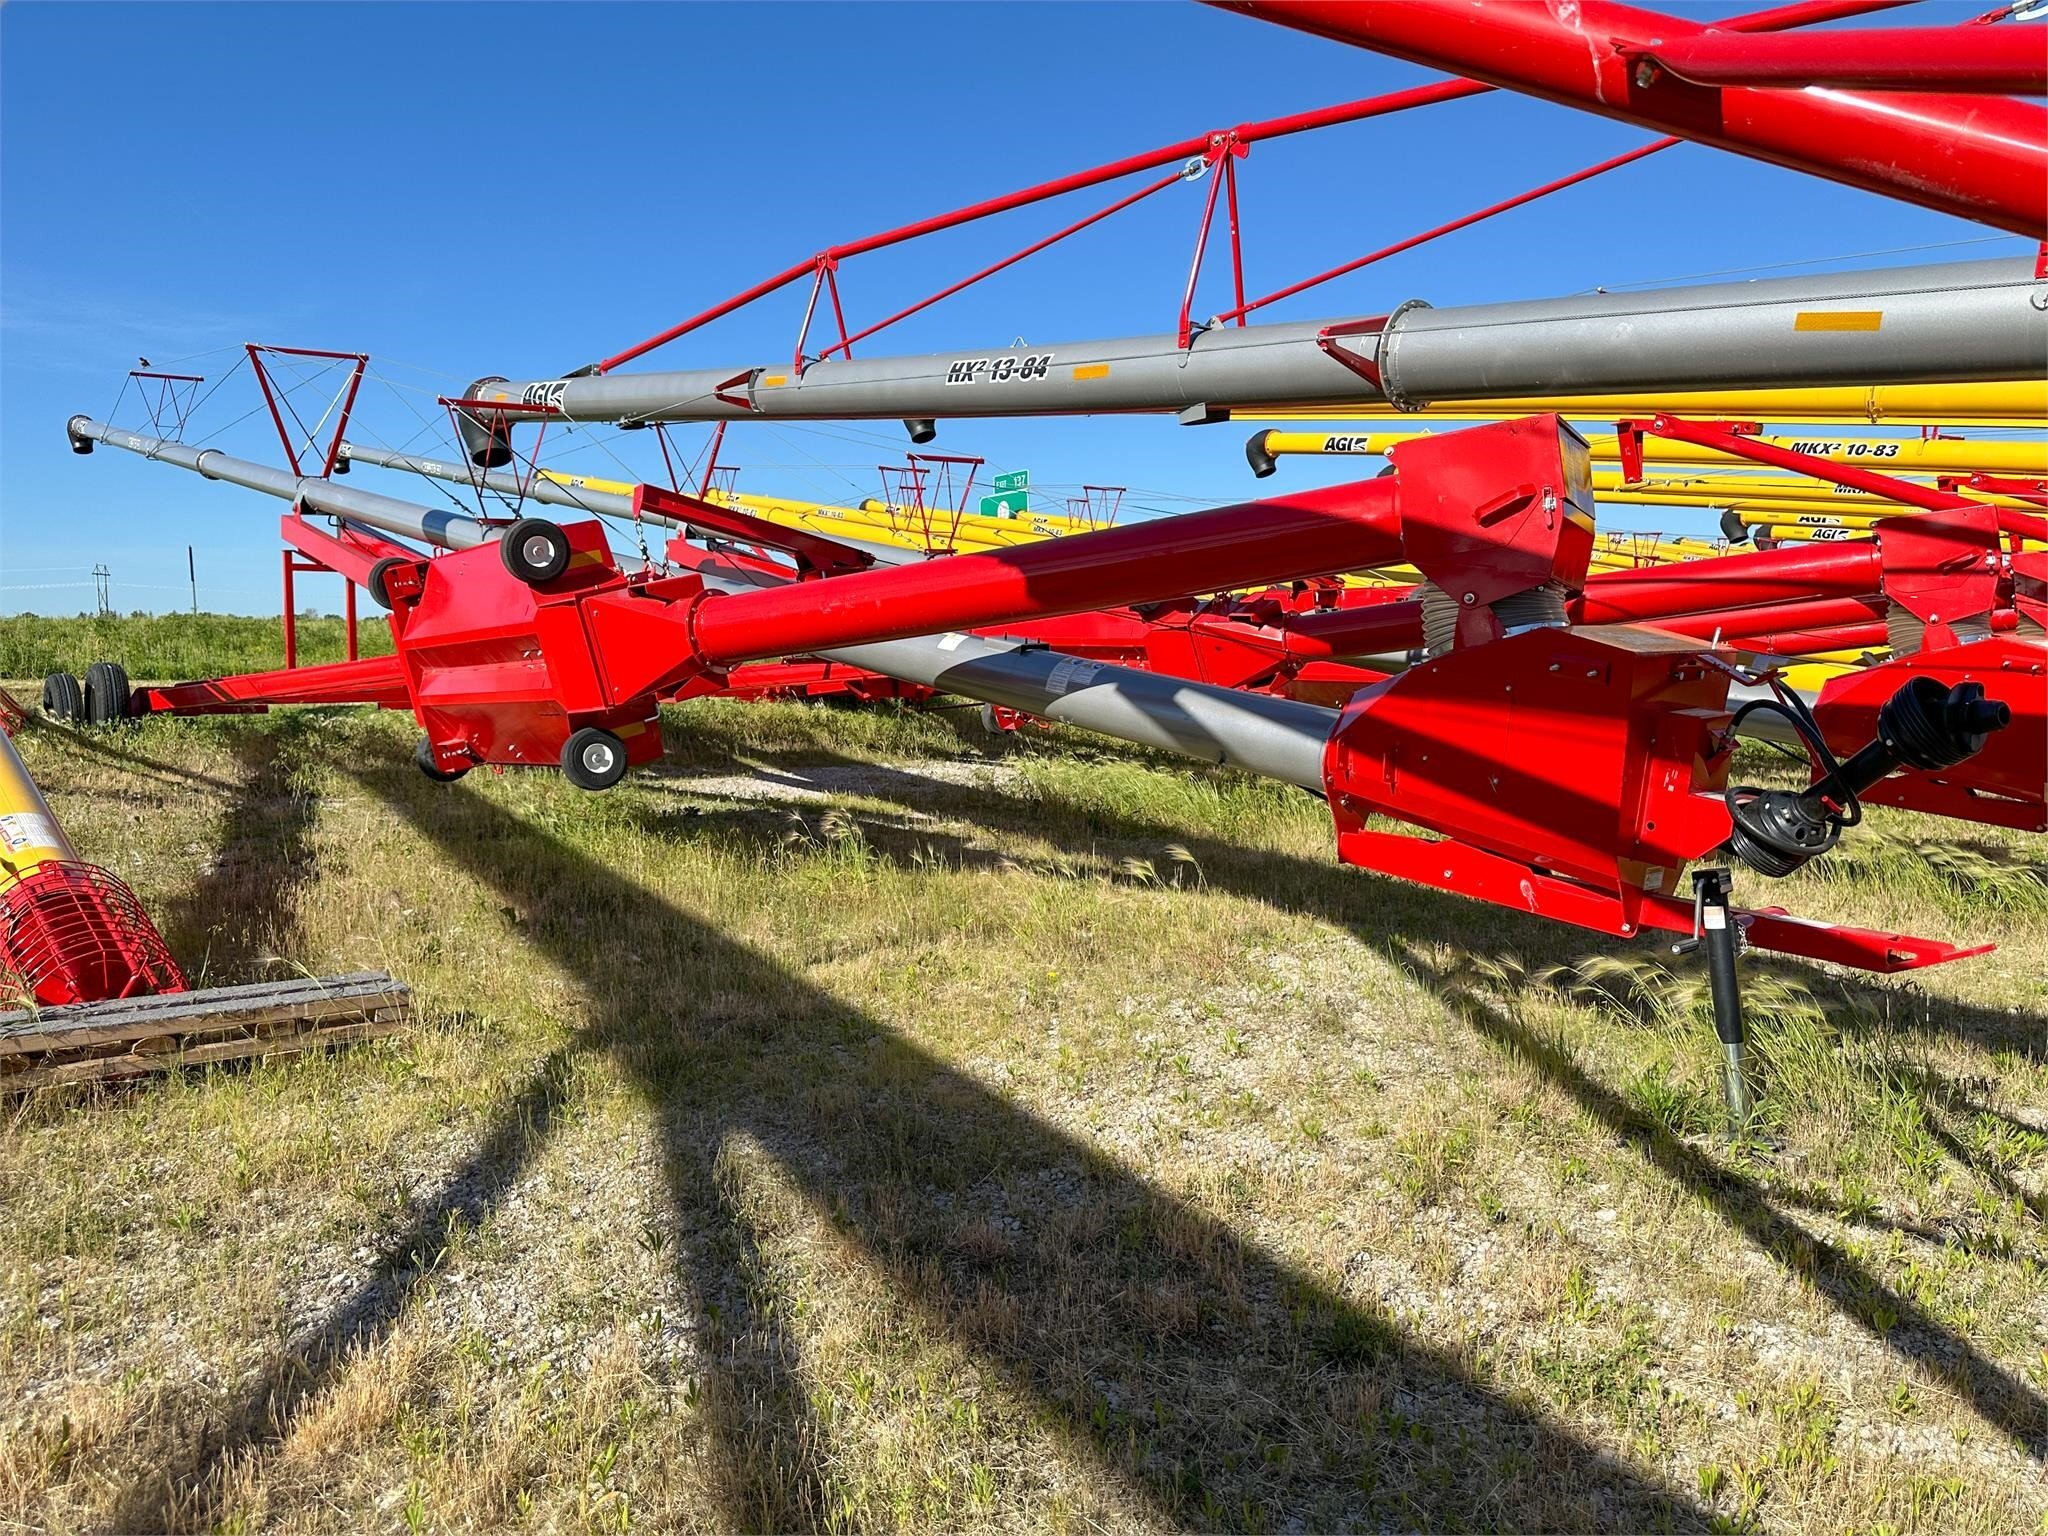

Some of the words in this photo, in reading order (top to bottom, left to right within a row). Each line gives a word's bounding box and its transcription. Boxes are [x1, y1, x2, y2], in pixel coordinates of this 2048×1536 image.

[946, 359, 987, 383] HX²
[991, 355, 1051, 381] 13-84
[1324, 437, 1354, 452] AGI
[1791, 442, 1842, 455] MKX²
[1847, 444, 1899, 457] 10-83
[1812, 528, 1837, 539] AGI
